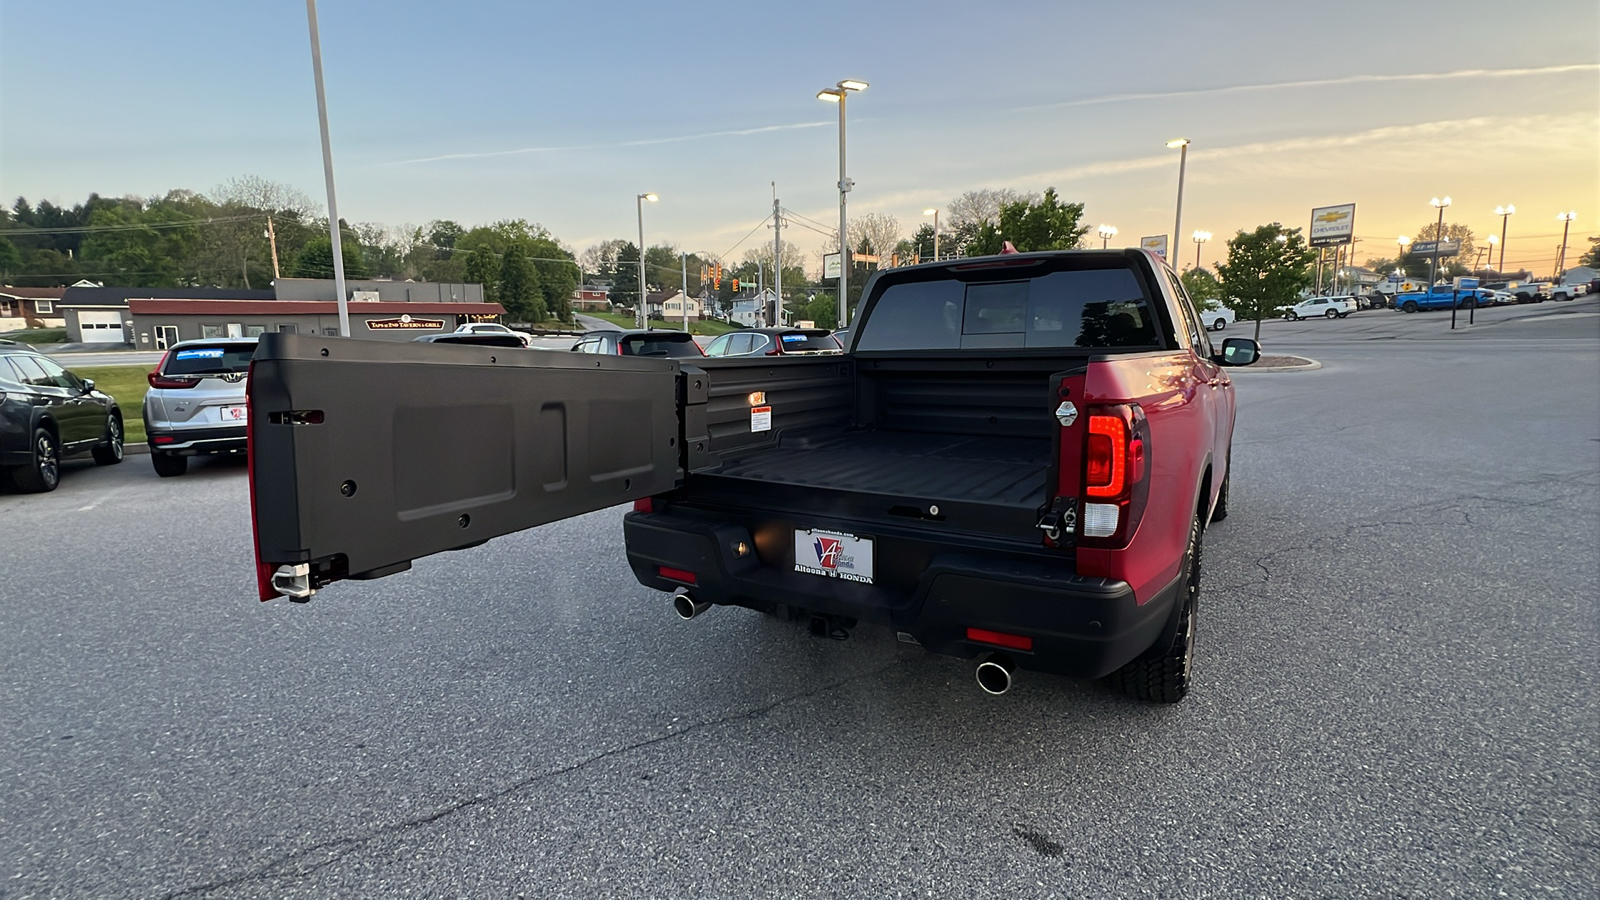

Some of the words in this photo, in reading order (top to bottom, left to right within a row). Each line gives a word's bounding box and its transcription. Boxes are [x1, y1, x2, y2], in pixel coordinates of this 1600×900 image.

[1313, 225, 1349, 234] CHEVROLET
[794, 564, 827, 576] Altoona
[840, 572, 873, 584] HONDA
